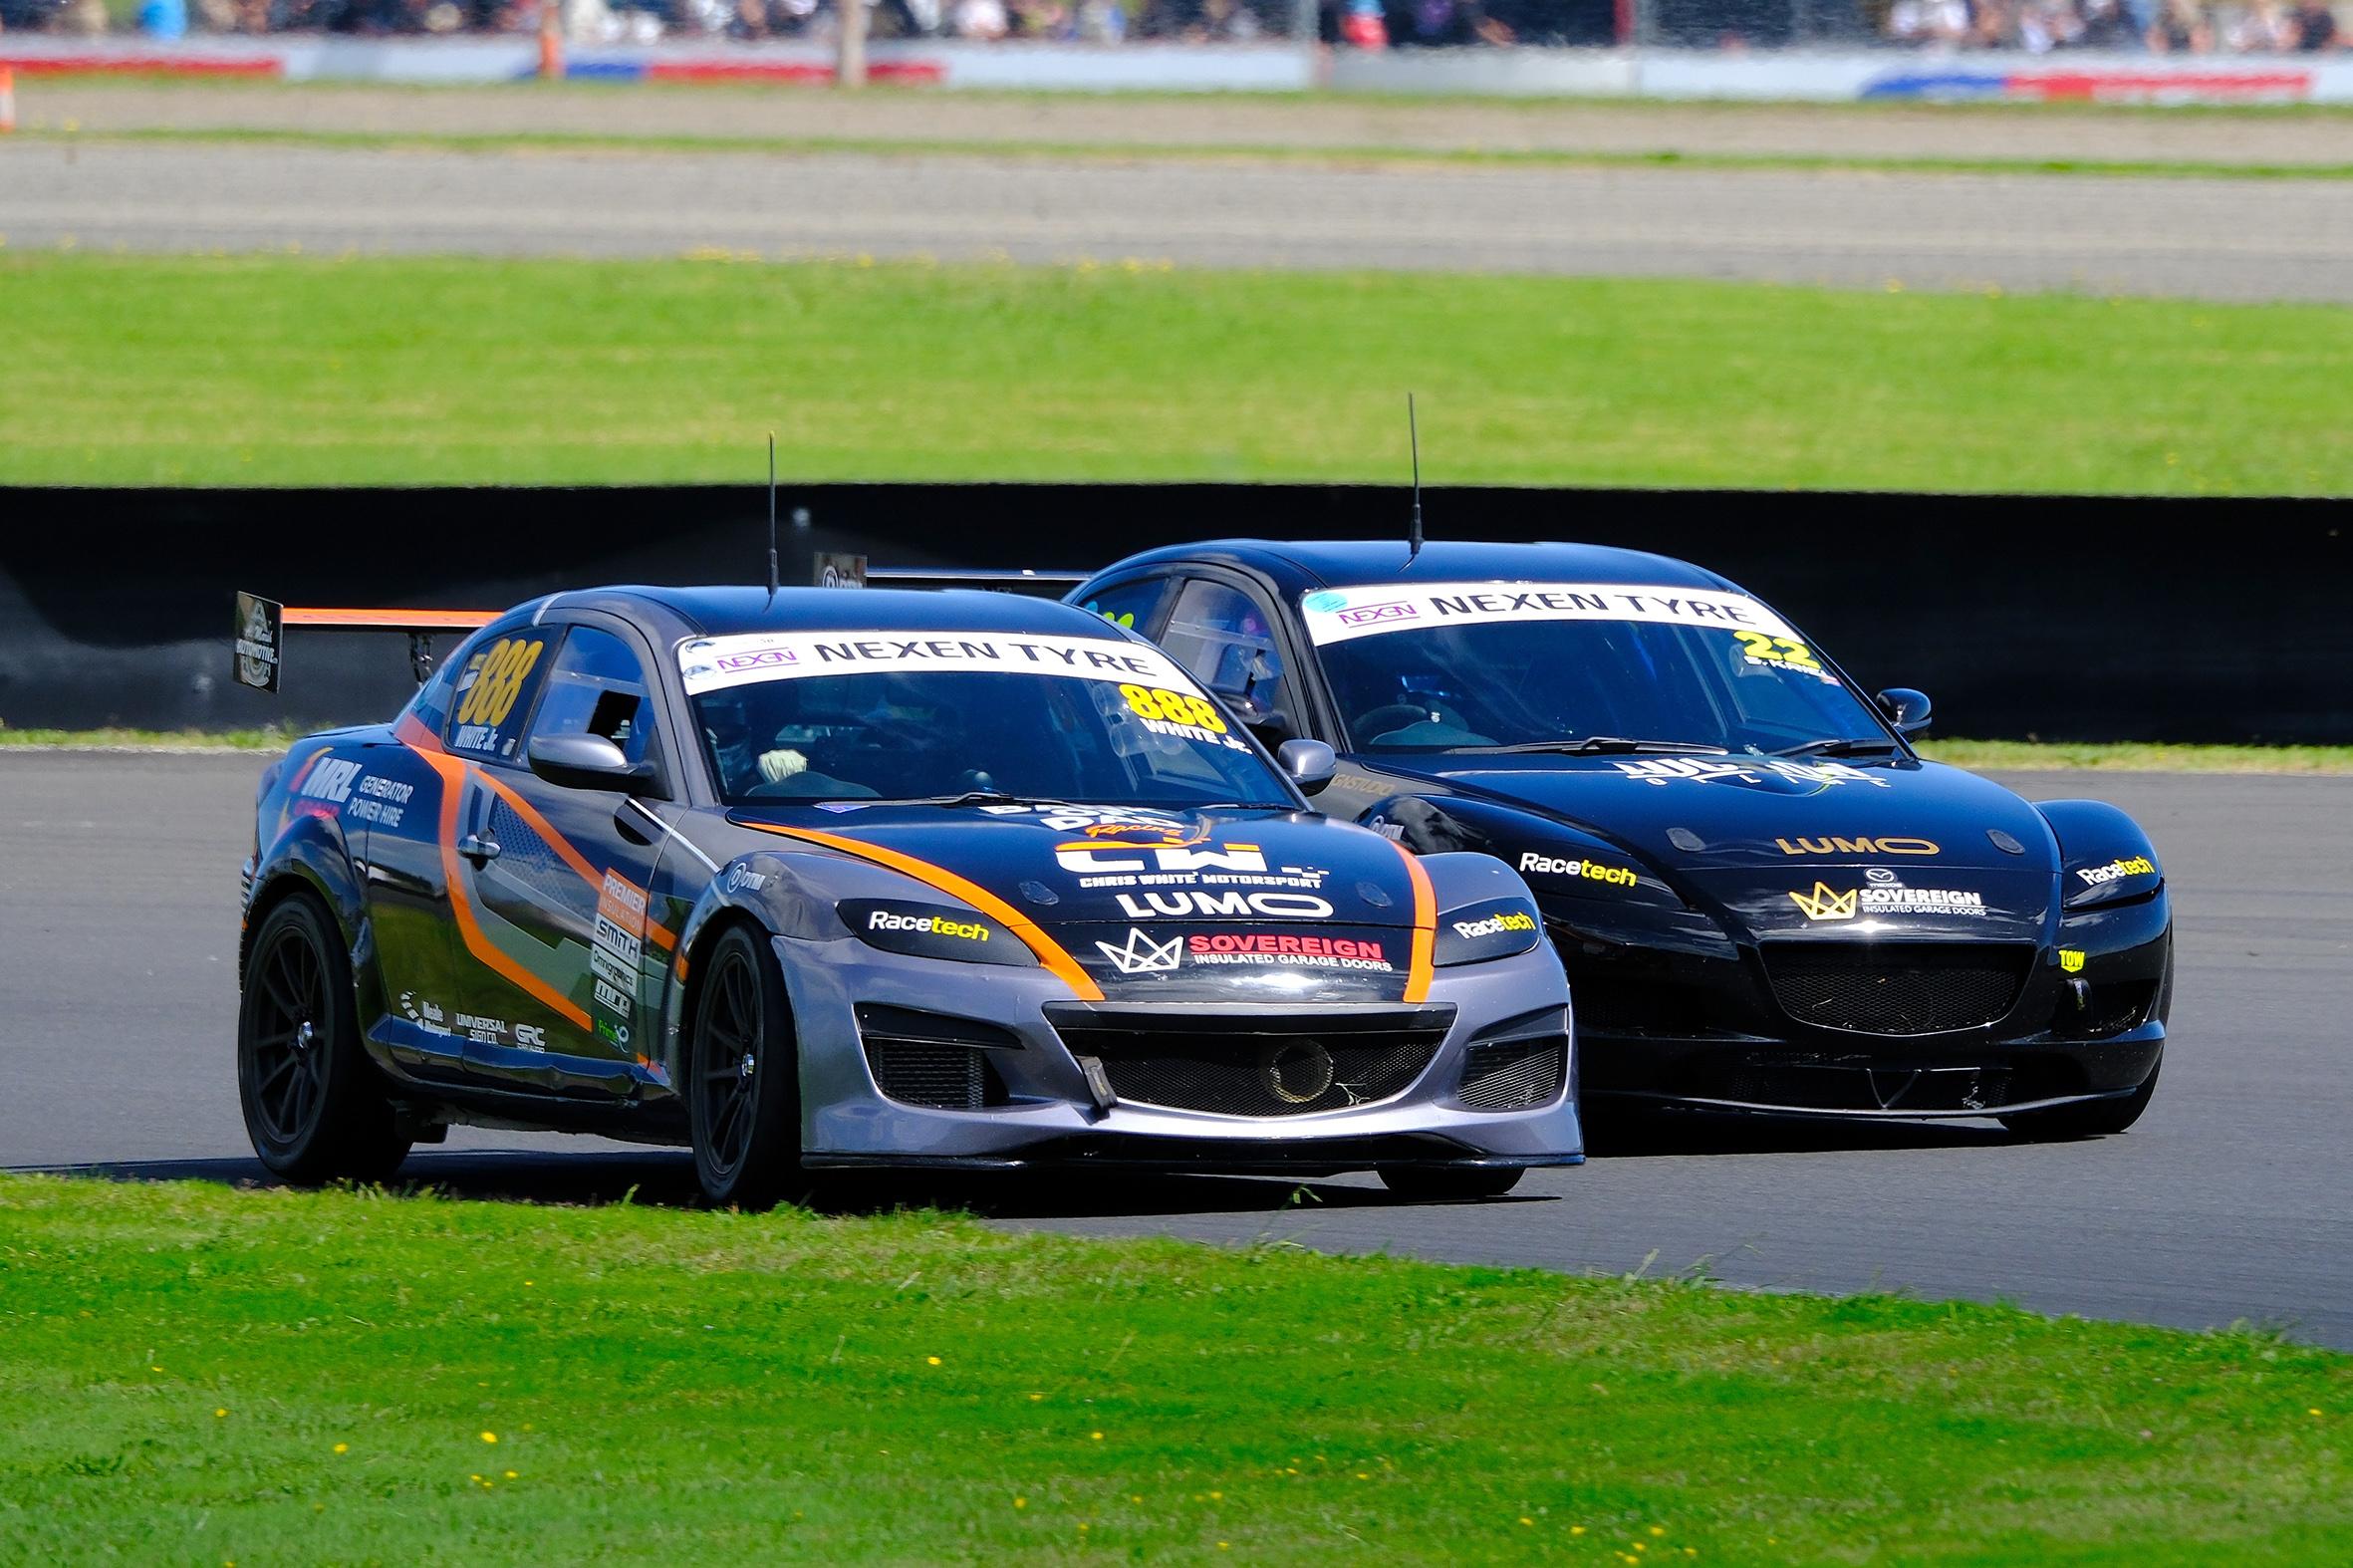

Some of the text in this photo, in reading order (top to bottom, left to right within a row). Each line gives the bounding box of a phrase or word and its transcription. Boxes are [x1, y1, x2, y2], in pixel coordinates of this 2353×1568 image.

[1430, 594, 1756, 625] NEXEN TYRE
[813, 642, 1157, 676] NEXEN TYRE
[1733, 631, 1822, 669] 22
[457, 639, 544, 726] 888
[1119, 683, 1227, 734] 888
[454, 724, 488, 749] WHITE
[1139, 717, 1221, 745] WHITE
[301, 757, 363, 803] MRL
[360, 775, 414, 804] GENERATOR
[348, 797, 383, 822] POWER
[379, 804, 404, 828] HIRE
[1775, 837, 1941, 856] LUMO
[1079, 873, 1323, 889] CHRIS WHITE MOTORSPORT
[1519, 852, 1638, 887] Racetech
[2076, 856, 2156, 886] Racetech
[603, 873, 647, 915] PREMIER
[1115, 892, 1335, 918] LUMO
[1859, 889, 1981, 906] SOVEREIGN
[1862, 905, 1912, 914] INSULATED
[1953, 908, 1986, 916] DOORS
[597, 918, 640, 959] SMITH
[868, 911, 990, 942] Racetech
[1452, 912, 1536, 939] Racetech
[1189, 934, 1383, 959] SOVEREIGN
[2058, 949, 2085, 967] TOW
[1194, 953, 1394, 972] INSULATED GARAGE DOORS
[455, 1012, 508, 1034] UNIVERSAL
[469, 1030, 487, 1044] SIGN
[514, 1023, 546, 1047] GRC
